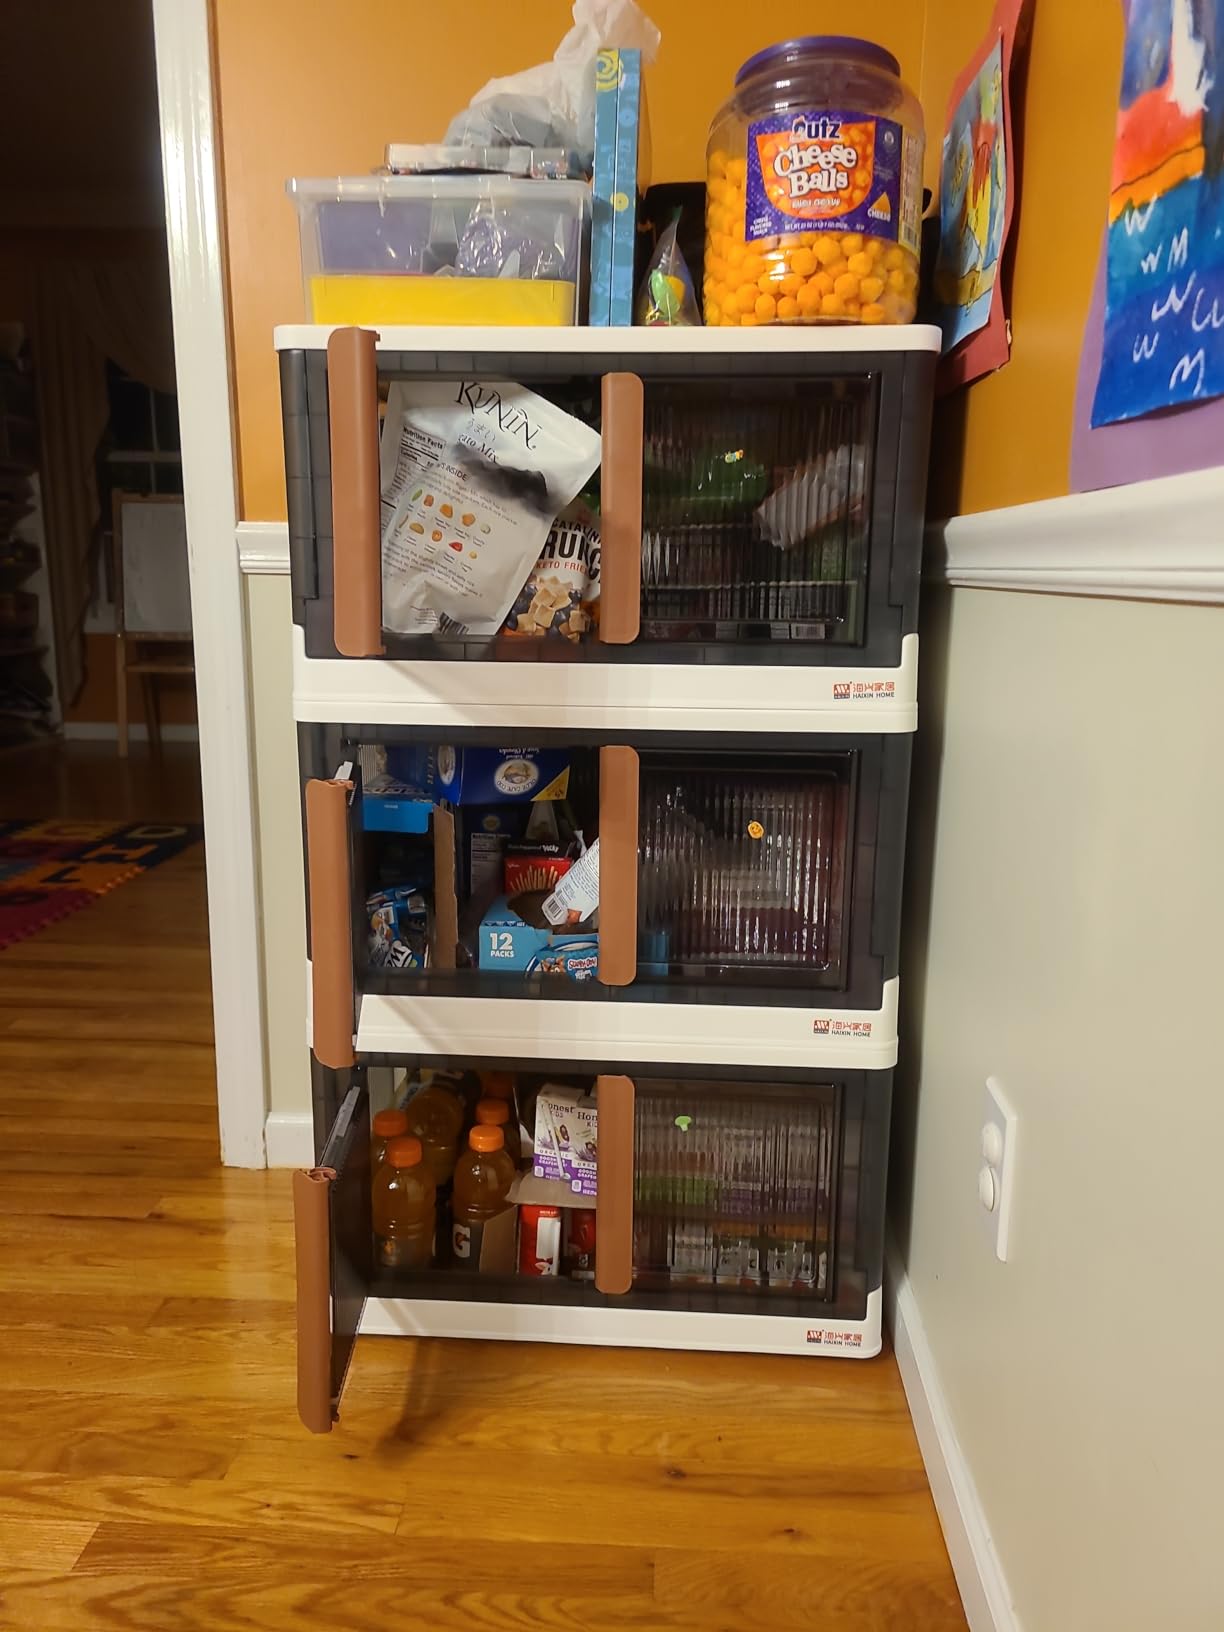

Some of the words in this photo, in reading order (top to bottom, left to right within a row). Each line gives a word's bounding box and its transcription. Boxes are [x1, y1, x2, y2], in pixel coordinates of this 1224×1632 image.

[774, 144, 858, 176] Cheese
[788, 168, 849, 198] Balls
[478, 442, 499, 463] Mix
[445, 465, 469, 481] INSIDE
[536, 561, 560, 569] KETO
[490, 932, 513, 950] 12
[490, 950, 514, 958] PACKS
[548, 1103, 576, 1114] onest
[540, 1150, 569, 1158] ORGAIC
